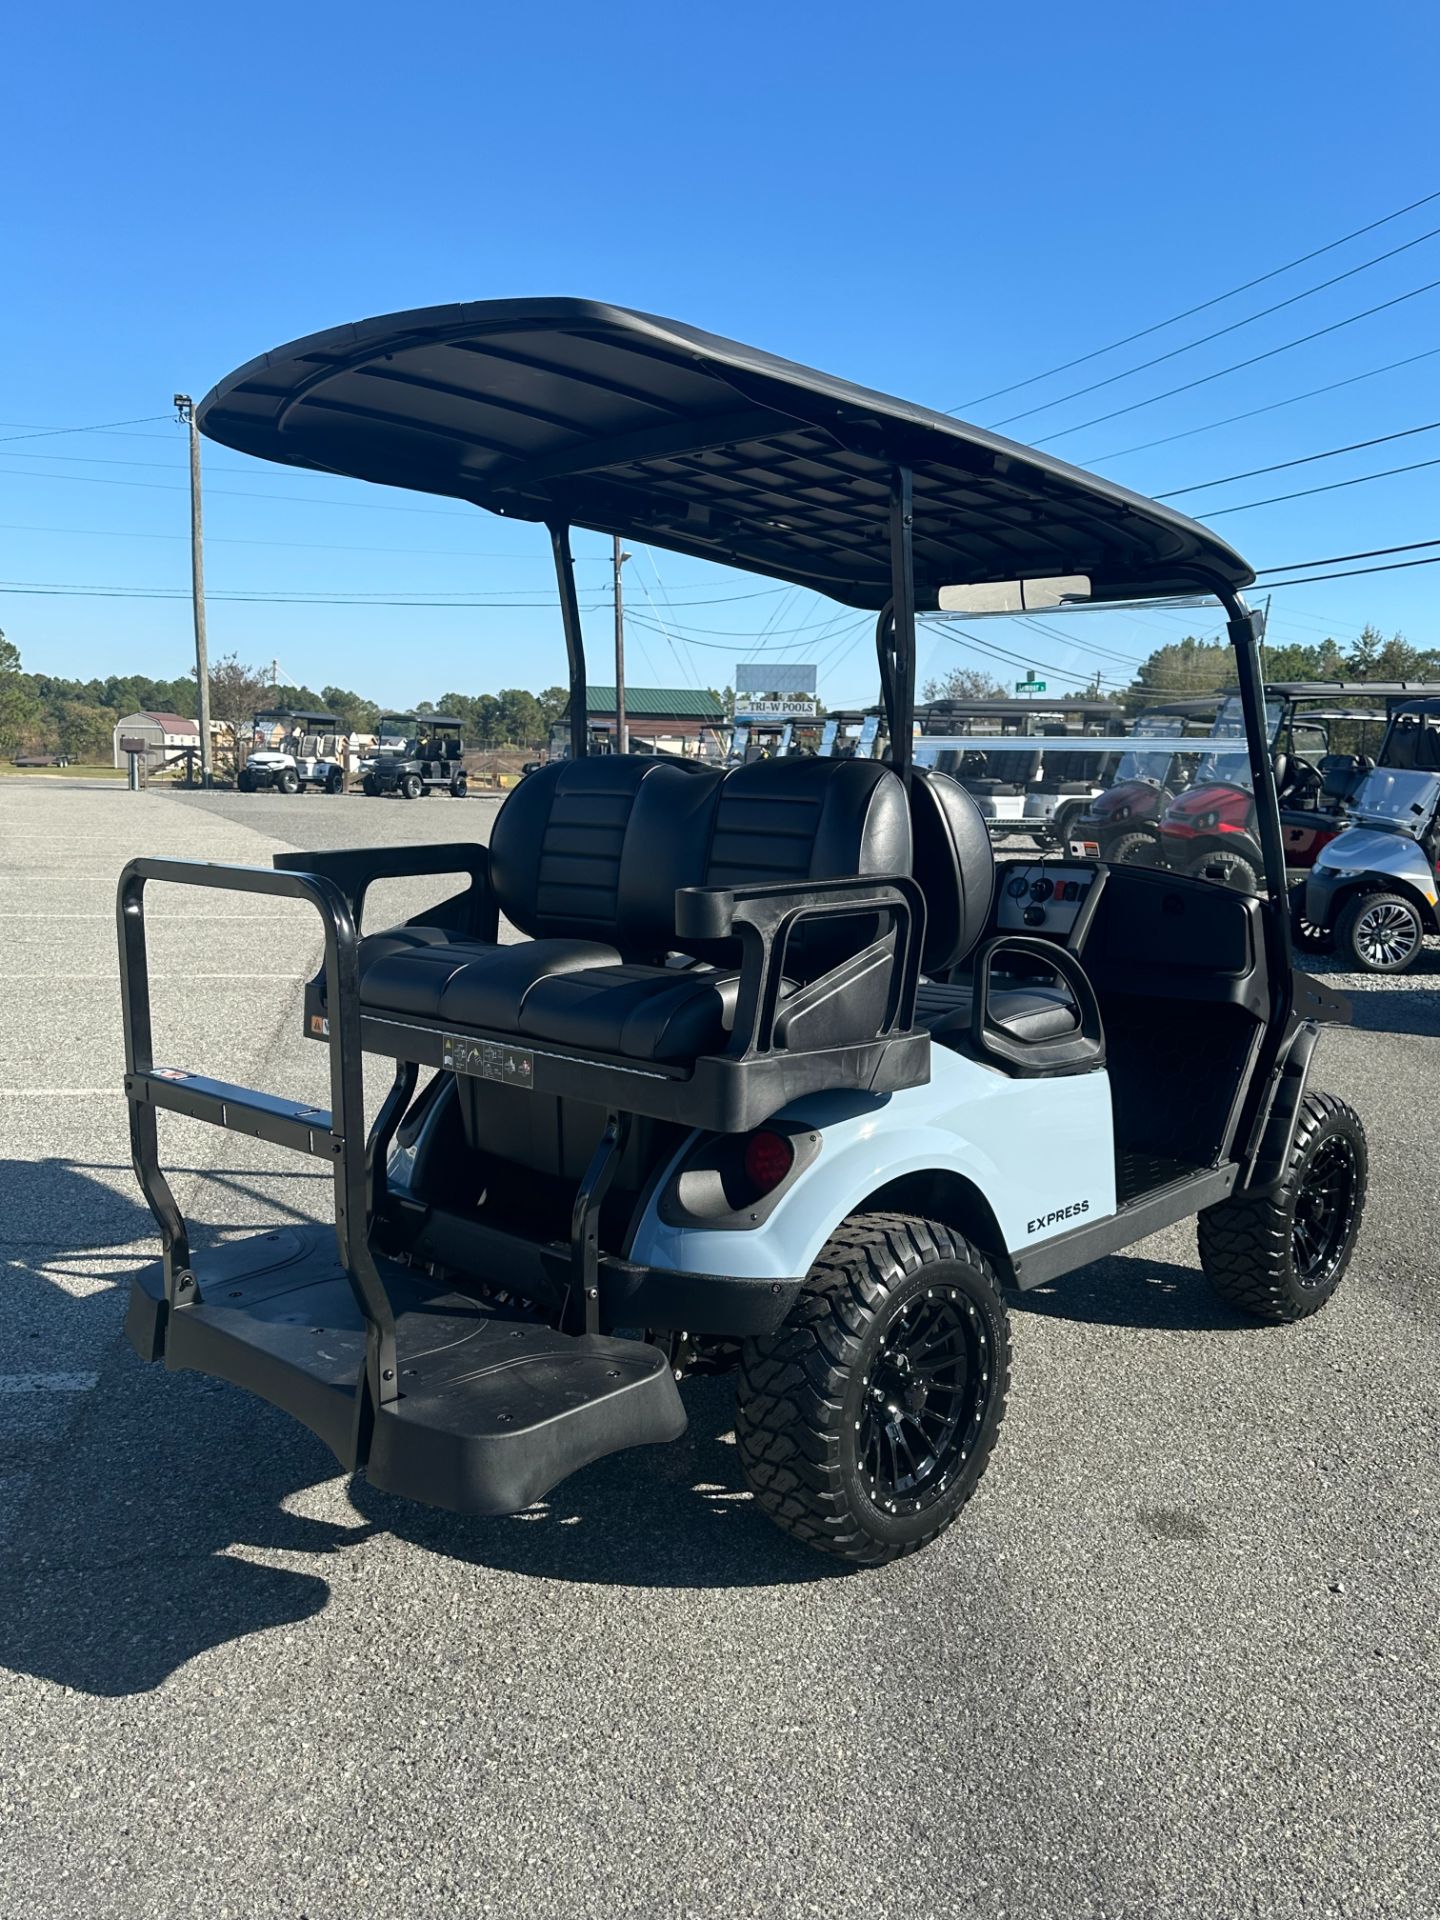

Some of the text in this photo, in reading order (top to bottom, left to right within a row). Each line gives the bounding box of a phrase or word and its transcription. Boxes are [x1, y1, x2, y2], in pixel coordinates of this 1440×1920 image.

[750, 702, 813, 712] TRI-W POOLS
[1027, 1199, 1090, 1234] EXPRESS
